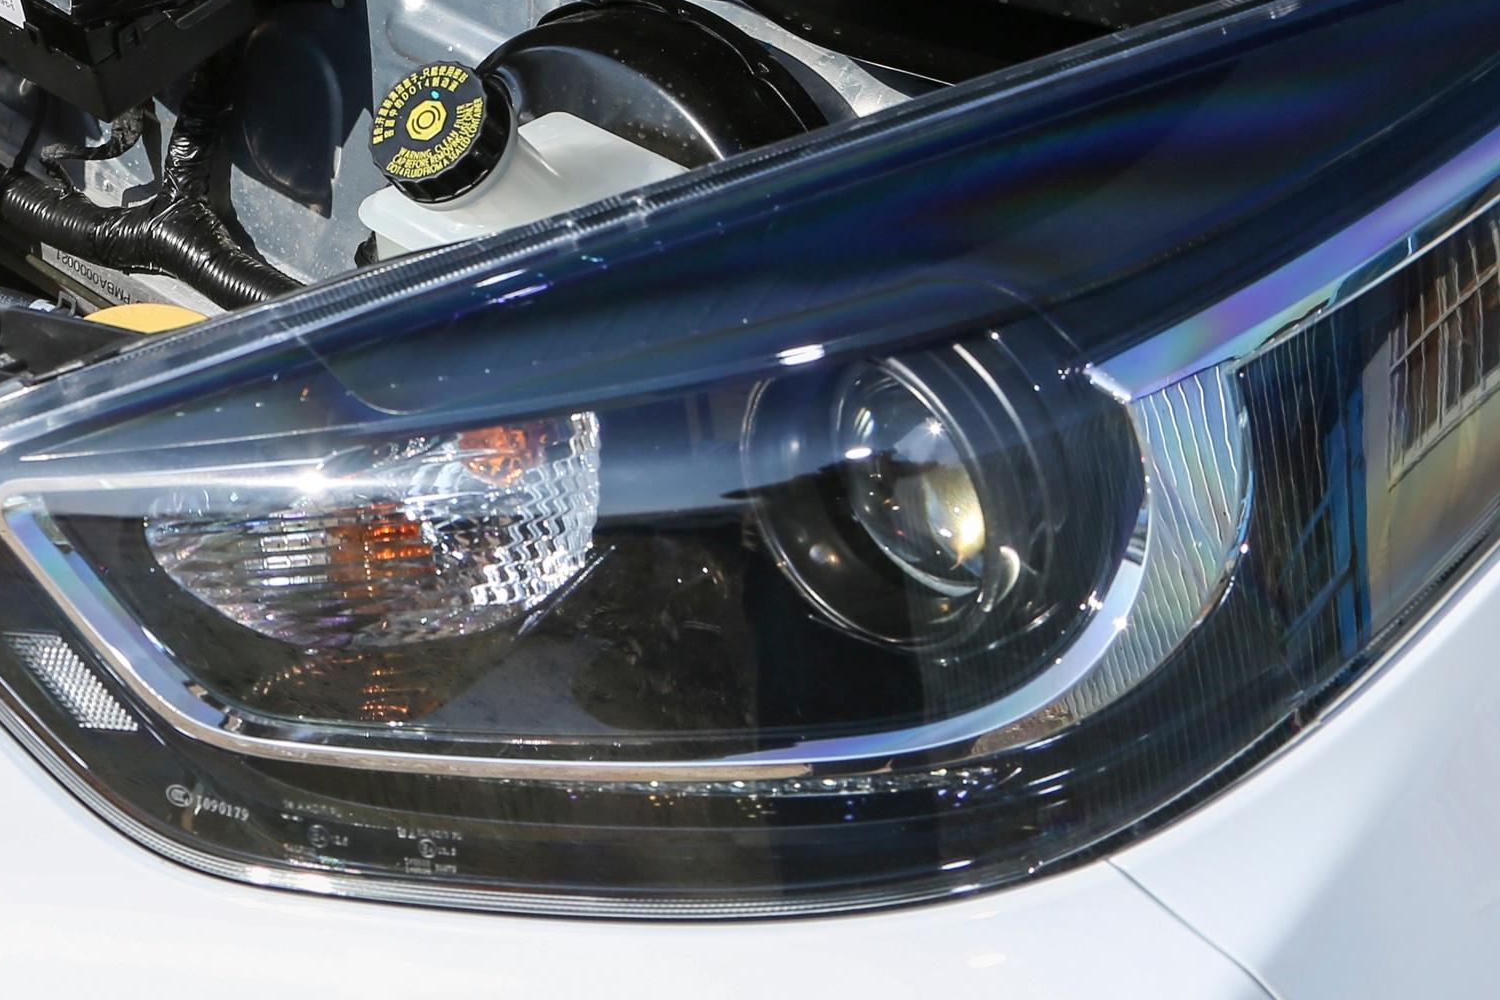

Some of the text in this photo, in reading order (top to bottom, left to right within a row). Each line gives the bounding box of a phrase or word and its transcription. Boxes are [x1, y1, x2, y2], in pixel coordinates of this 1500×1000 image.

[404, 168, 423, 178] FLUID
[423, 162, 443, 176] FROM
[448, 136, 471, 161] SEALED
[467, 97, 483, 138] CONTAINER
[435, 129, 458, 153] CLEAN
[393, 154, 406, 165] CAP
[405, 158, 430, 169] BEFORE
